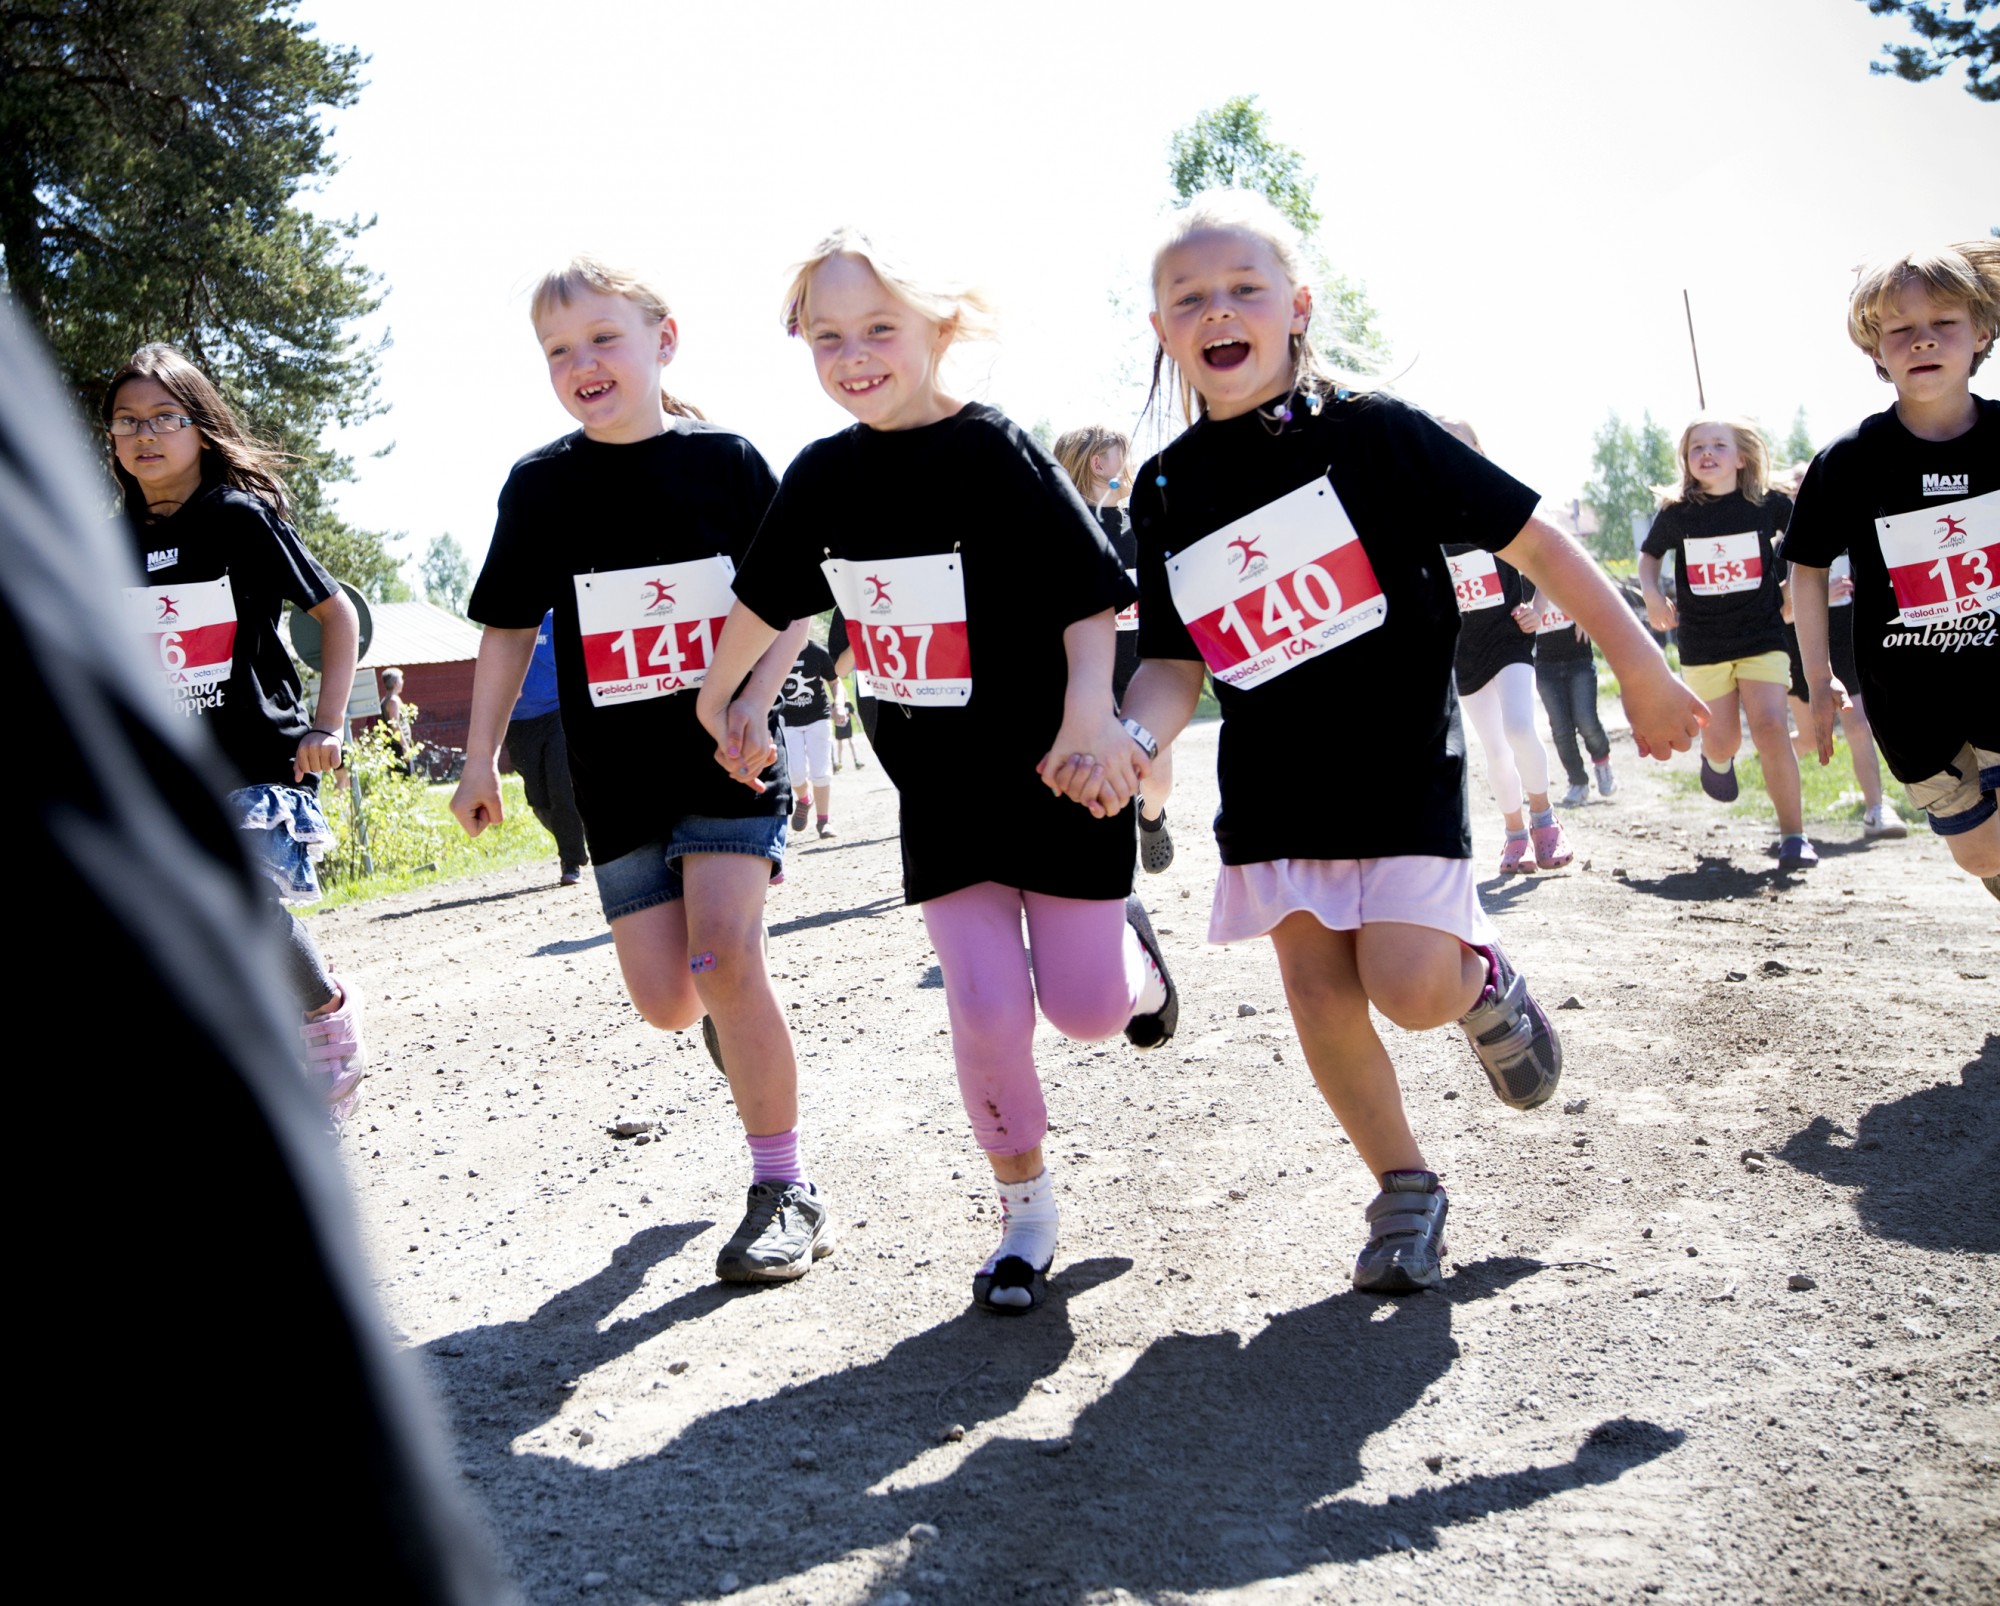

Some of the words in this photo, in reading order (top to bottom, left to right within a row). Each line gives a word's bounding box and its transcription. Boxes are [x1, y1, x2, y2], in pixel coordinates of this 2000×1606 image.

[1922, 473, 1969, 487] MAXI
[147, 548, 178, 565] MAXI
[1698, 560, 1748, 585] 153
[1218, 563, 1343, 658] 140
[1955, 597, 1983, 614] ICA
[1281, 637, 1318, 661] ICA
[1321, 603, 1385, 639] octapharma
[1883, 622, 1999, 653] omloppet
[610, 618, 715, 680] 141
[861, 624, 934, 680] 137
[656, 676, 686, 692] ICA
[890, 681, 912, 699] ICA
[916, 685, 968, 696] octapharma
